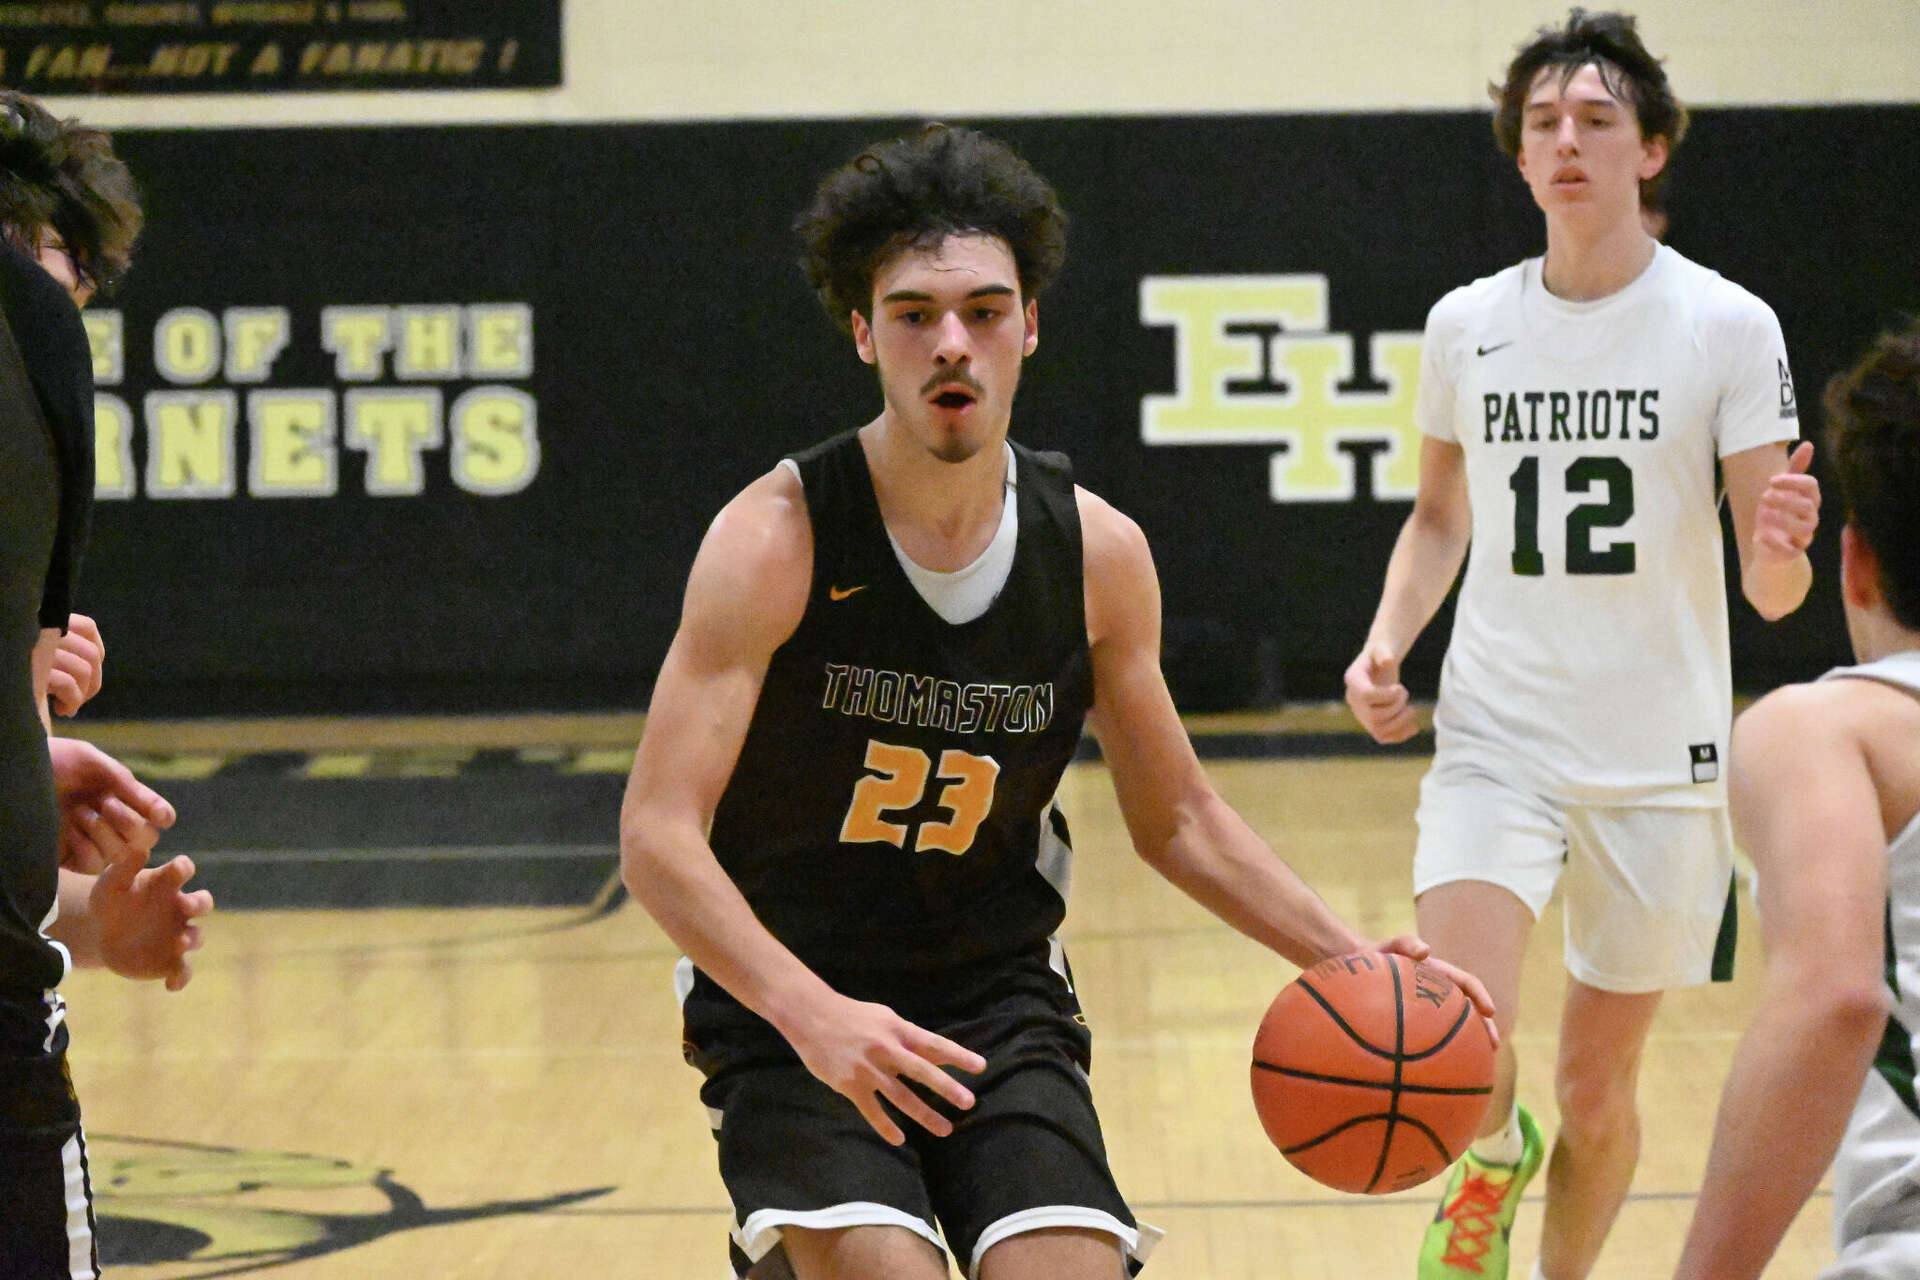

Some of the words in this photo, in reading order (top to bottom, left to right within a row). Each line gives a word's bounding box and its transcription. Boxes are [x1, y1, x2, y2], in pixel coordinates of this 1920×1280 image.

[252, 43, 280, 74] A
[299, 39, 485, 75] FANATIC
[153, 306, 290, 384] OF
[321, 303, 534, 381] THE
[1484, 389, 1659, 442] PATRIOTS
[1509, 456, 1636, 576] 12
[822, 662, 1054, 734] THOMASTON
[839, 739, 1001, 856] 23
